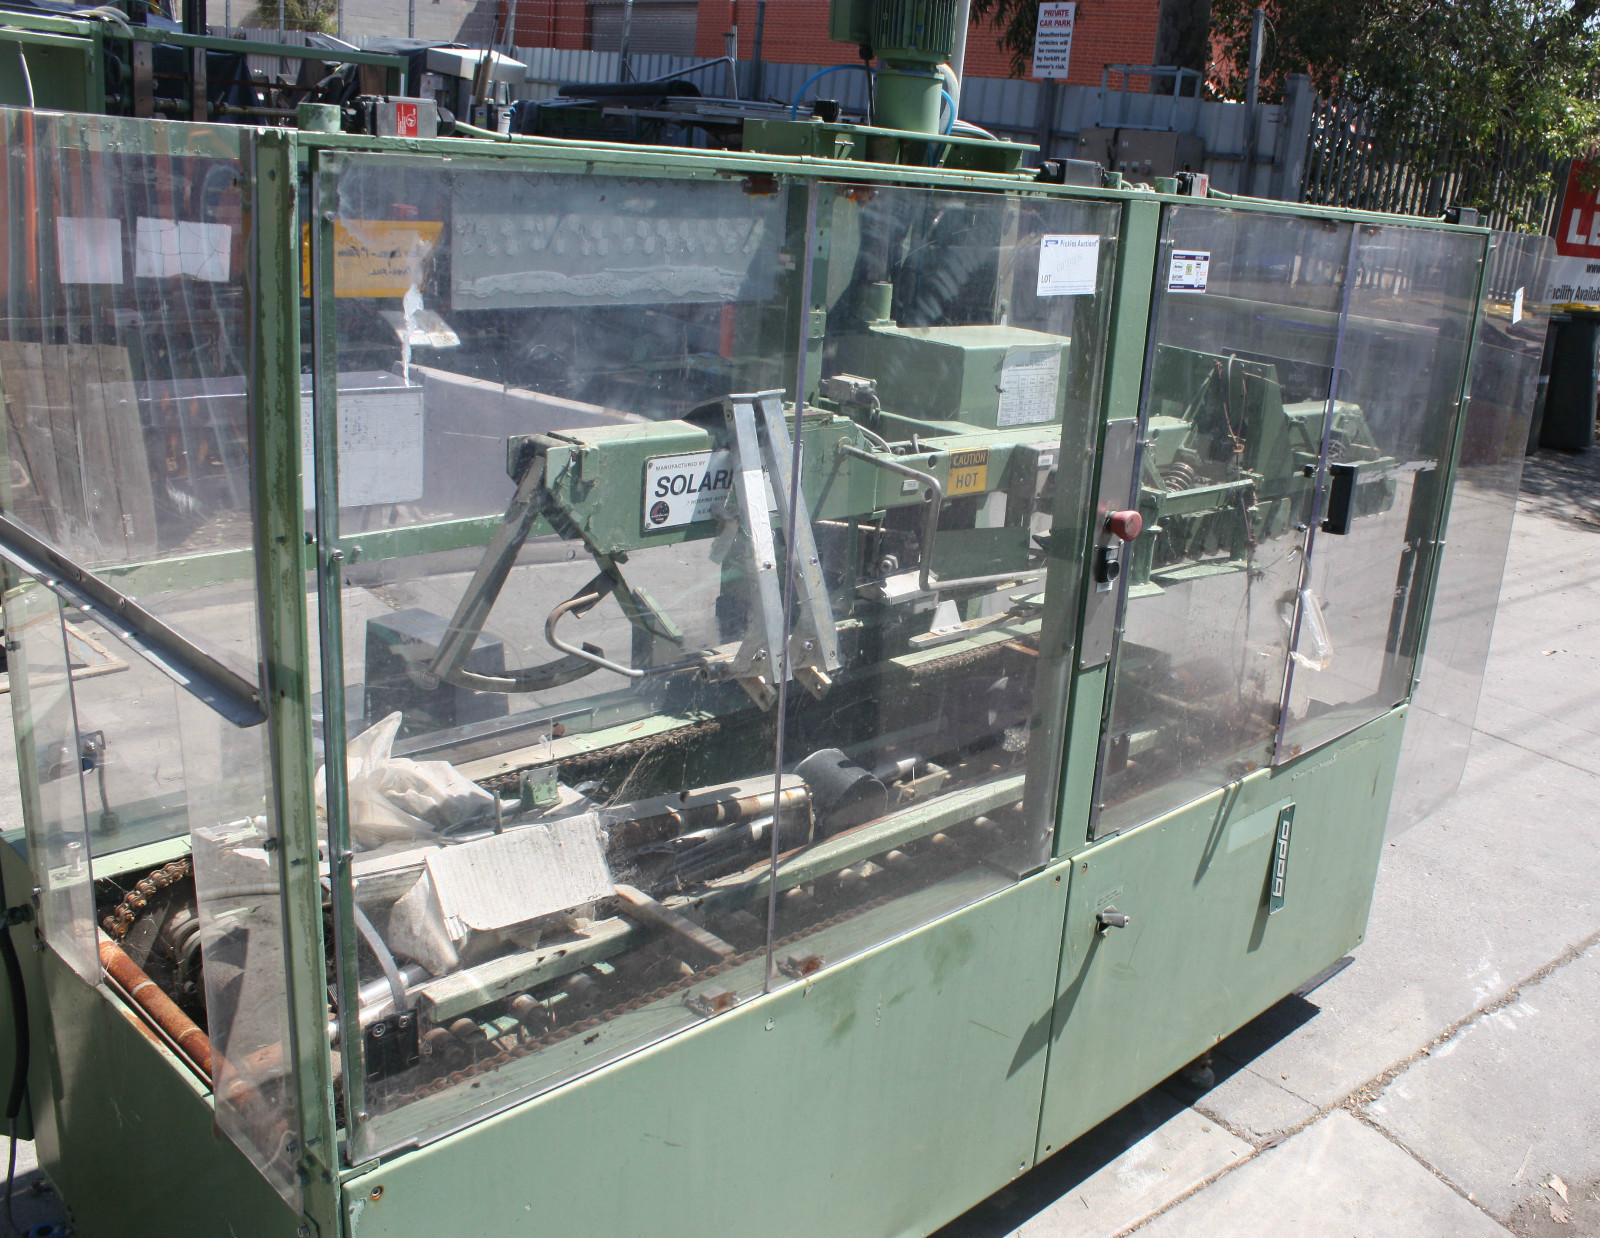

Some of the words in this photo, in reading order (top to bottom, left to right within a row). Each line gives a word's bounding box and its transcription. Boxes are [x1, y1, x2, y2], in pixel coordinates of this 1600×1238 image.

[1044, 9, 1070, 17] PRIVATE
[1060, 239, 1076, 248] Pickles
[1041, 274, 1052, 284] LOT
[954, 453, 986, 466] CAUTION
[656, 461, 698, 471] MANUFACTURED
[956, 472, 979, 489] HOT
